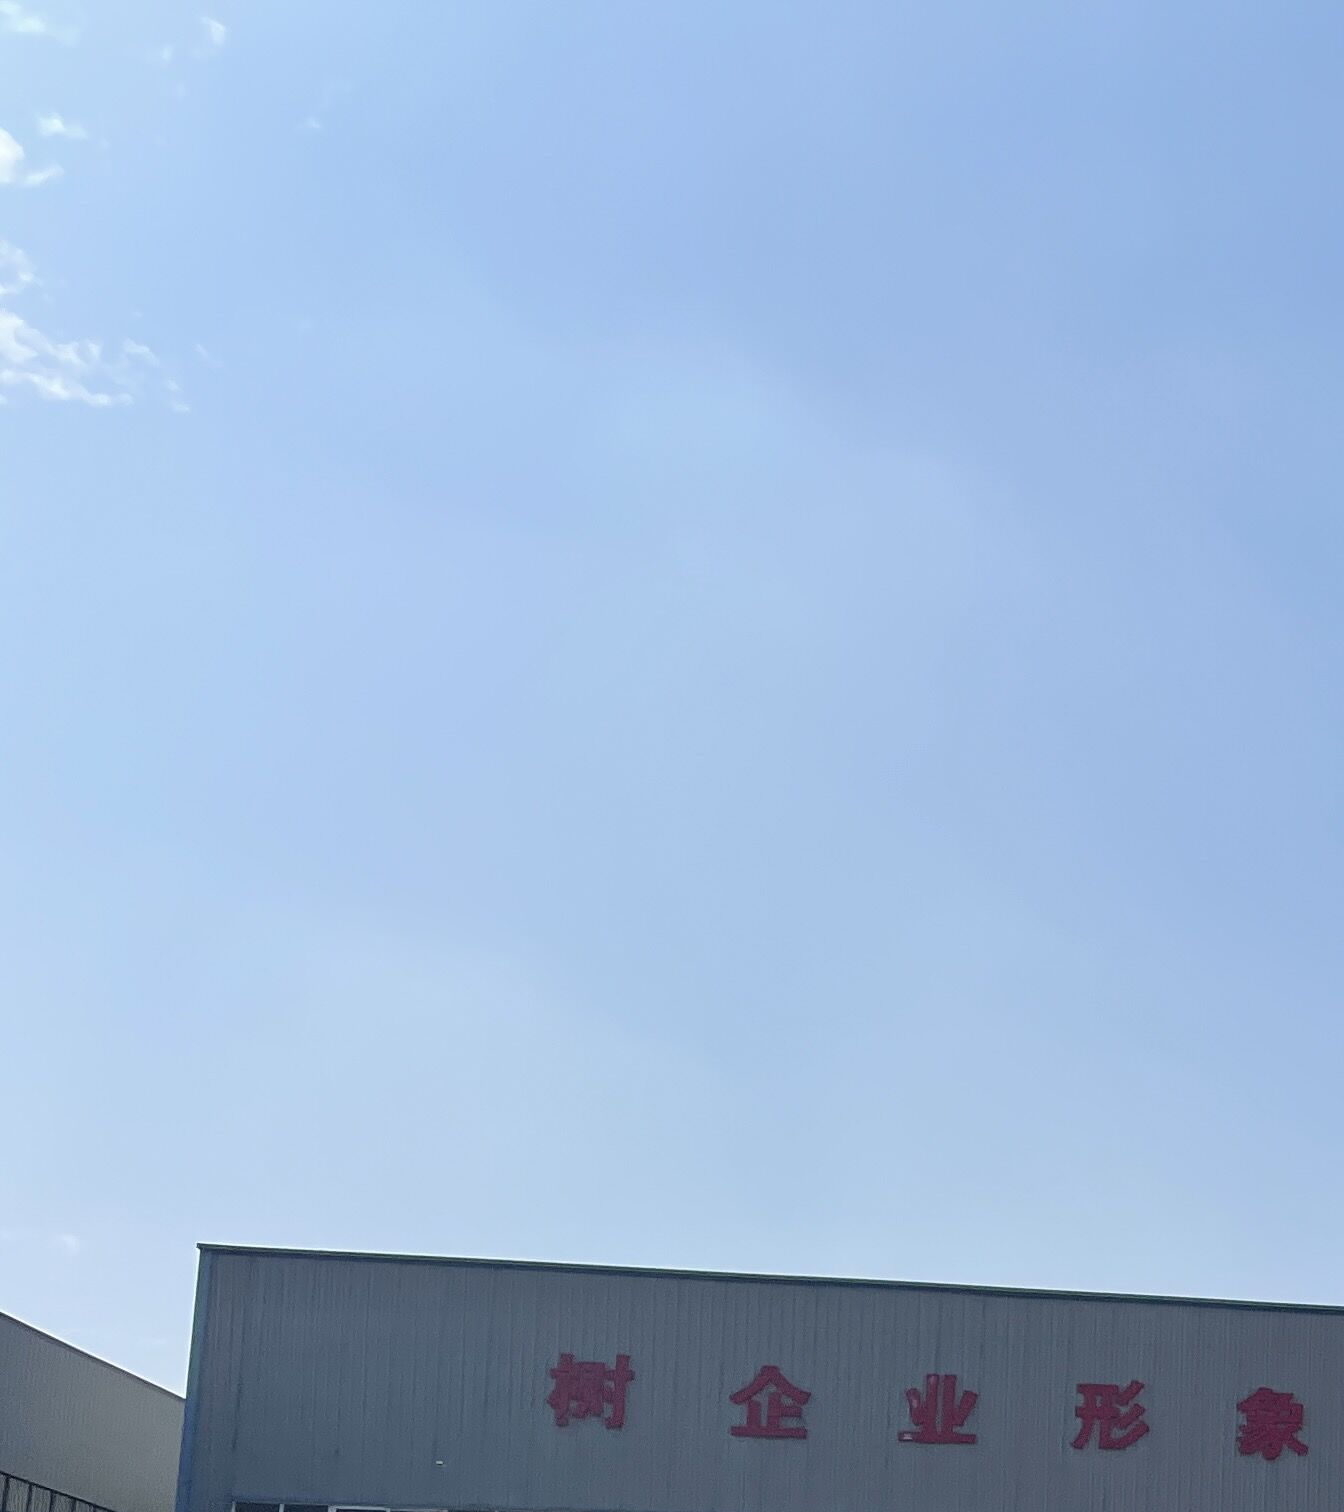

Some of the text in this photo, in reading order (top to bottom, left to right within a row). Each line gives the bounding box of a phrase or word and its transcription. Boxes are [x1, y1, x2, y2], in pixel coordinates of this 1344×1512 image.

[547, 1353, 1309, 1461] 树企业形象
